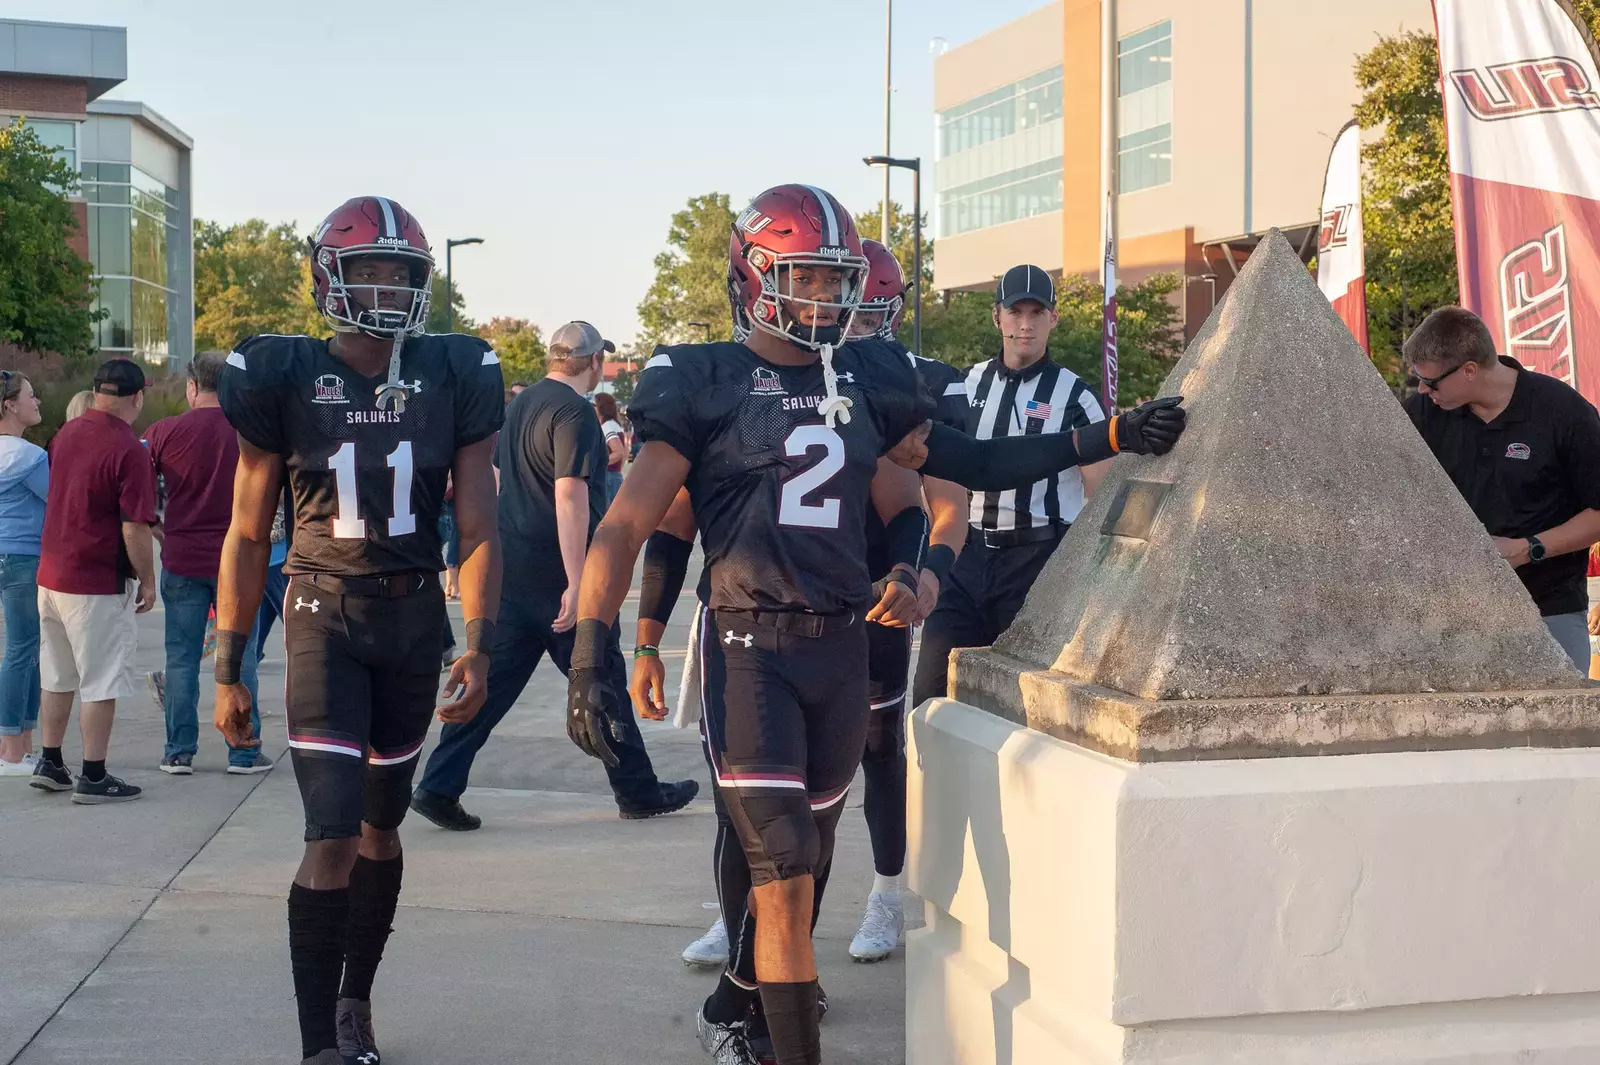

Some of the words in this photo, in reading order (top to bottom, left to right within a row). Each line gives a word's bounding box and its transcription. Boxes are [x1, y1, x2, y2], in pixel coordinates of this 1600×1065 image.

[782, 395, 826, 410] SALUK
[327, 440, 416, 539] 11
[779, 424, 846, 529] 2
